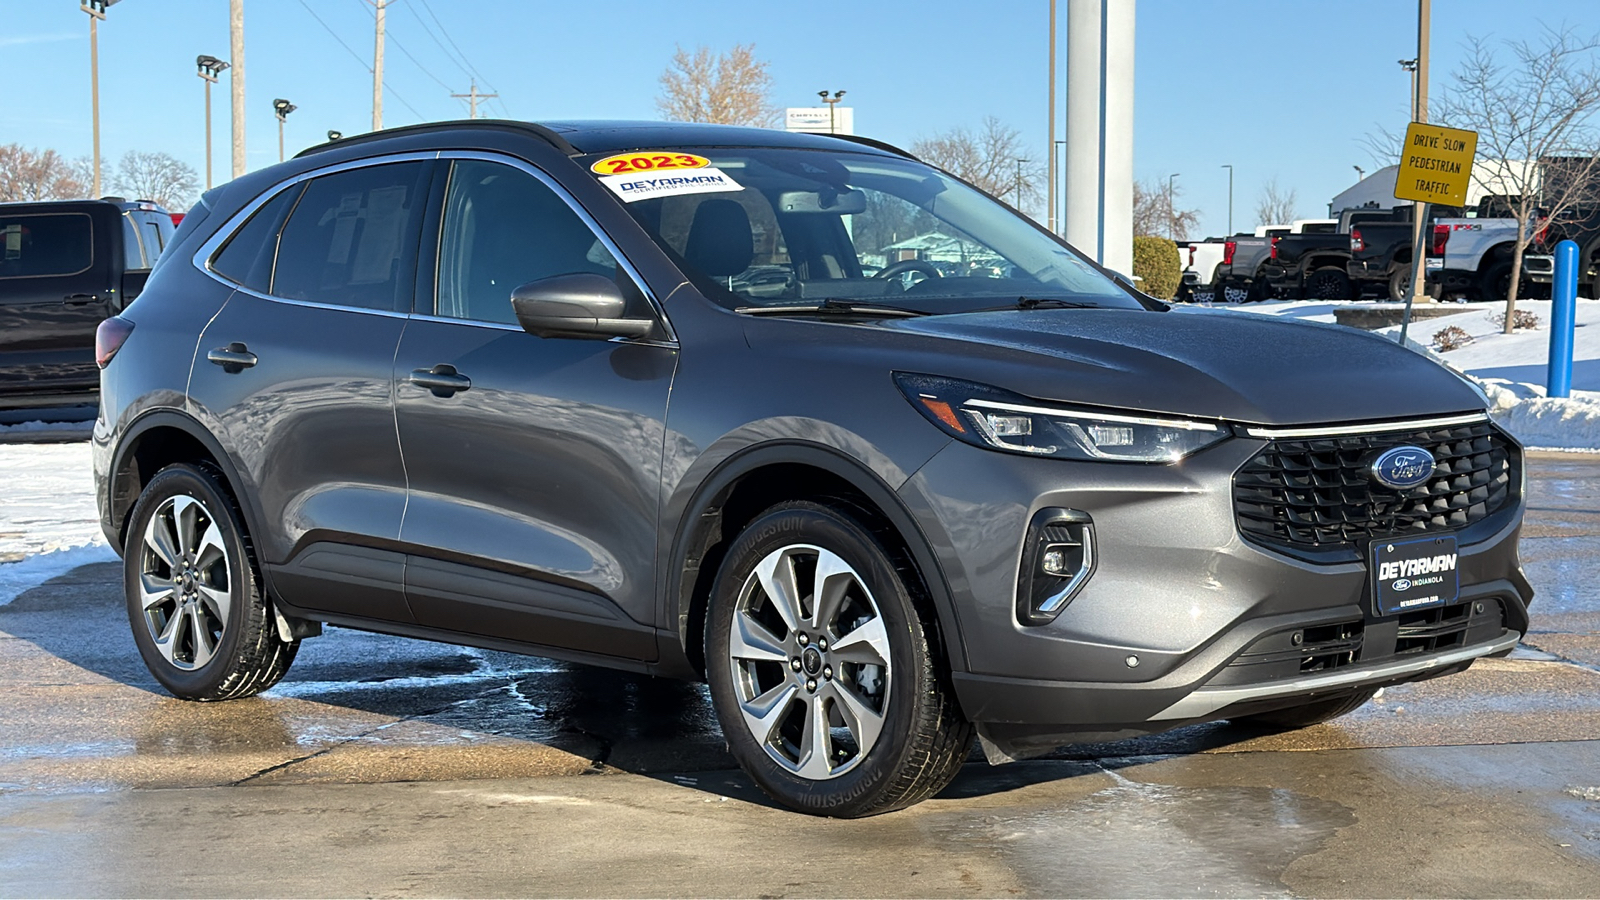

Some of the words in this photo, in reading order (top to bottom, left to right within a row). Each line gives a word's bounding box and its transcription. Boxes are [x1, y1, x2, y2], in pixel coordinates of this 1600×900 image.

[1413, 134, 1439, 148] DRIVE
[1443, 138, 1466, 152] SLOW
[607, 155, 700, 173] 2023
[1409, 155, 1461, 174] PEDESTRIAN
[620, 175, 724, 191] DEYARMAN
[633, 184, 677, 194] CERTIFIED
[1415, 179, 1450, 195] TRAFFIC
[1391, 455, 1425, 479] Ford
[1379, 553, 1458, 580] DEYARMAN
[1411, 576, 1444, 587] INDIANOLA
